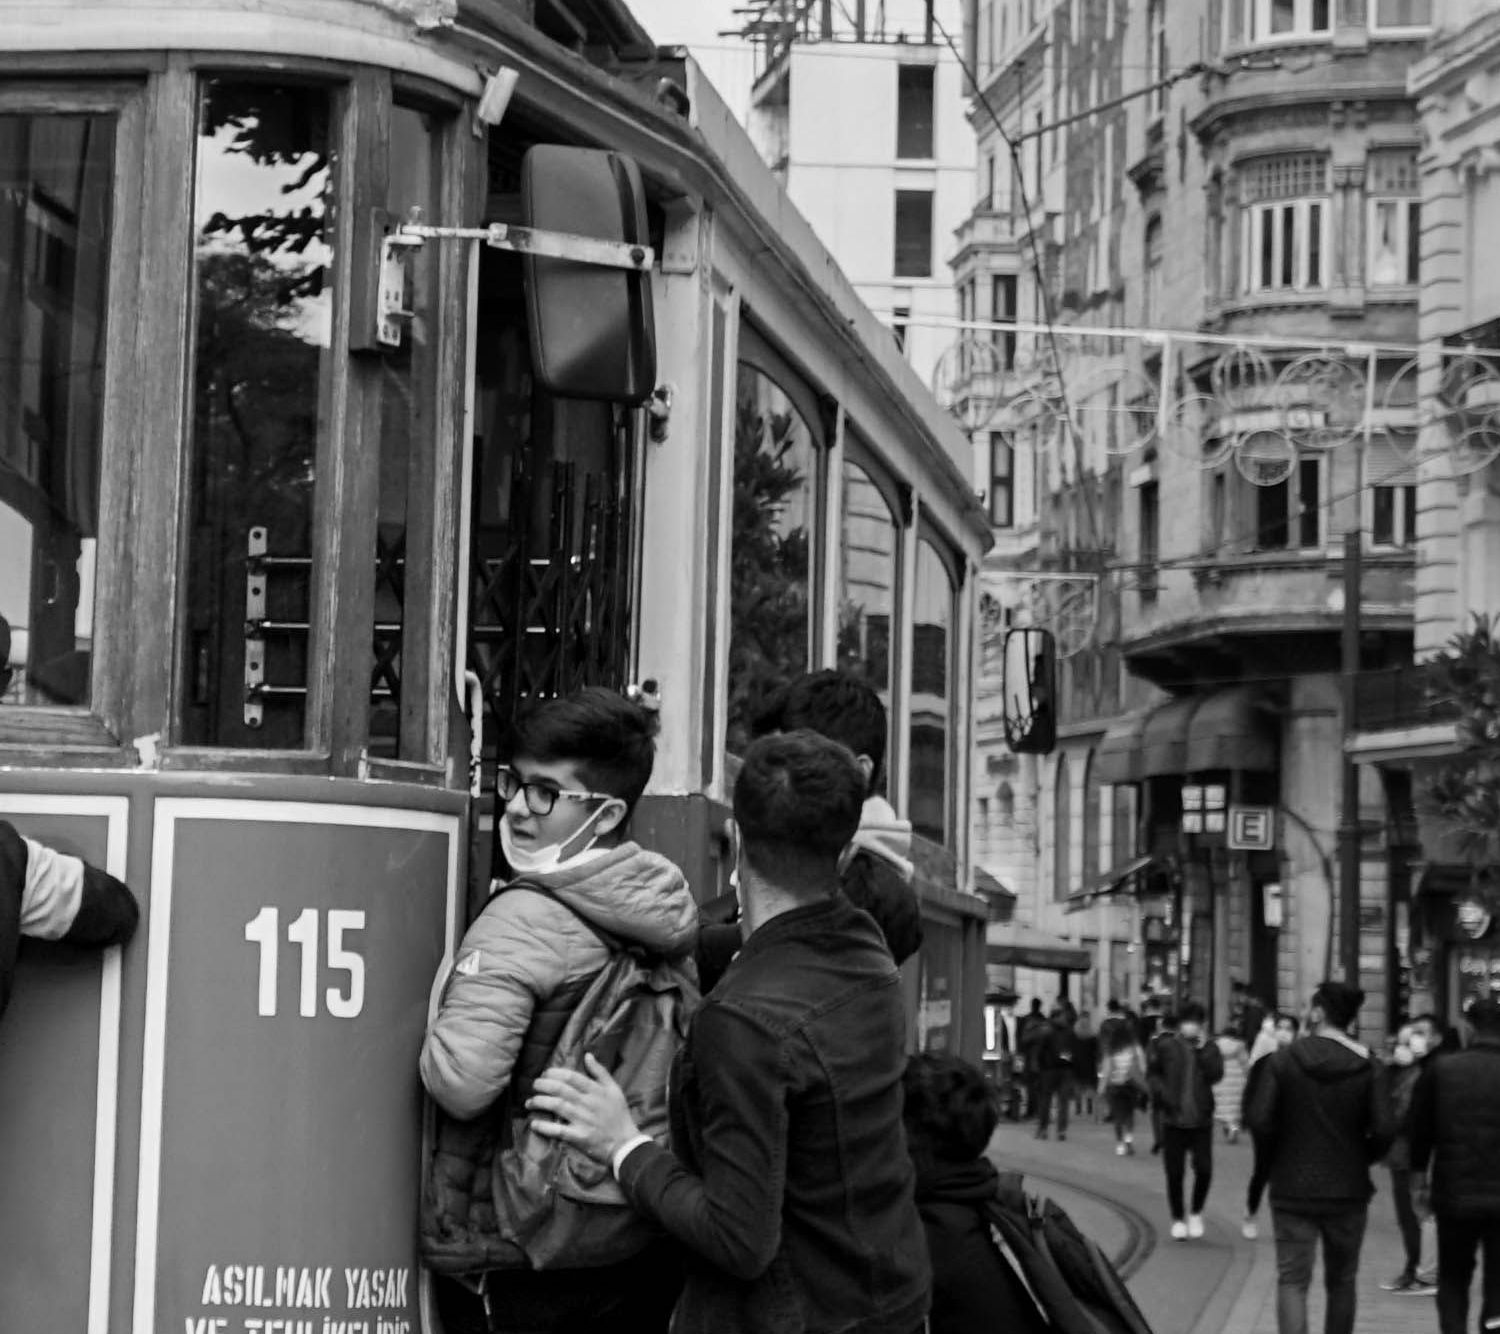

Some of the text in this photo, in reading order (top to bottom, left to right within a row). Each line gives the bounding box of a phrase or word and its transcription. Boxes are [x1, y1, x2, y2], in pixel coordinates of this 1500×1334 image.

[1243, 815, 1260, 842] E
[244, 906, 366, 1020] 115
[200, 1263, 409, 1309] ASILMAK YASAK
